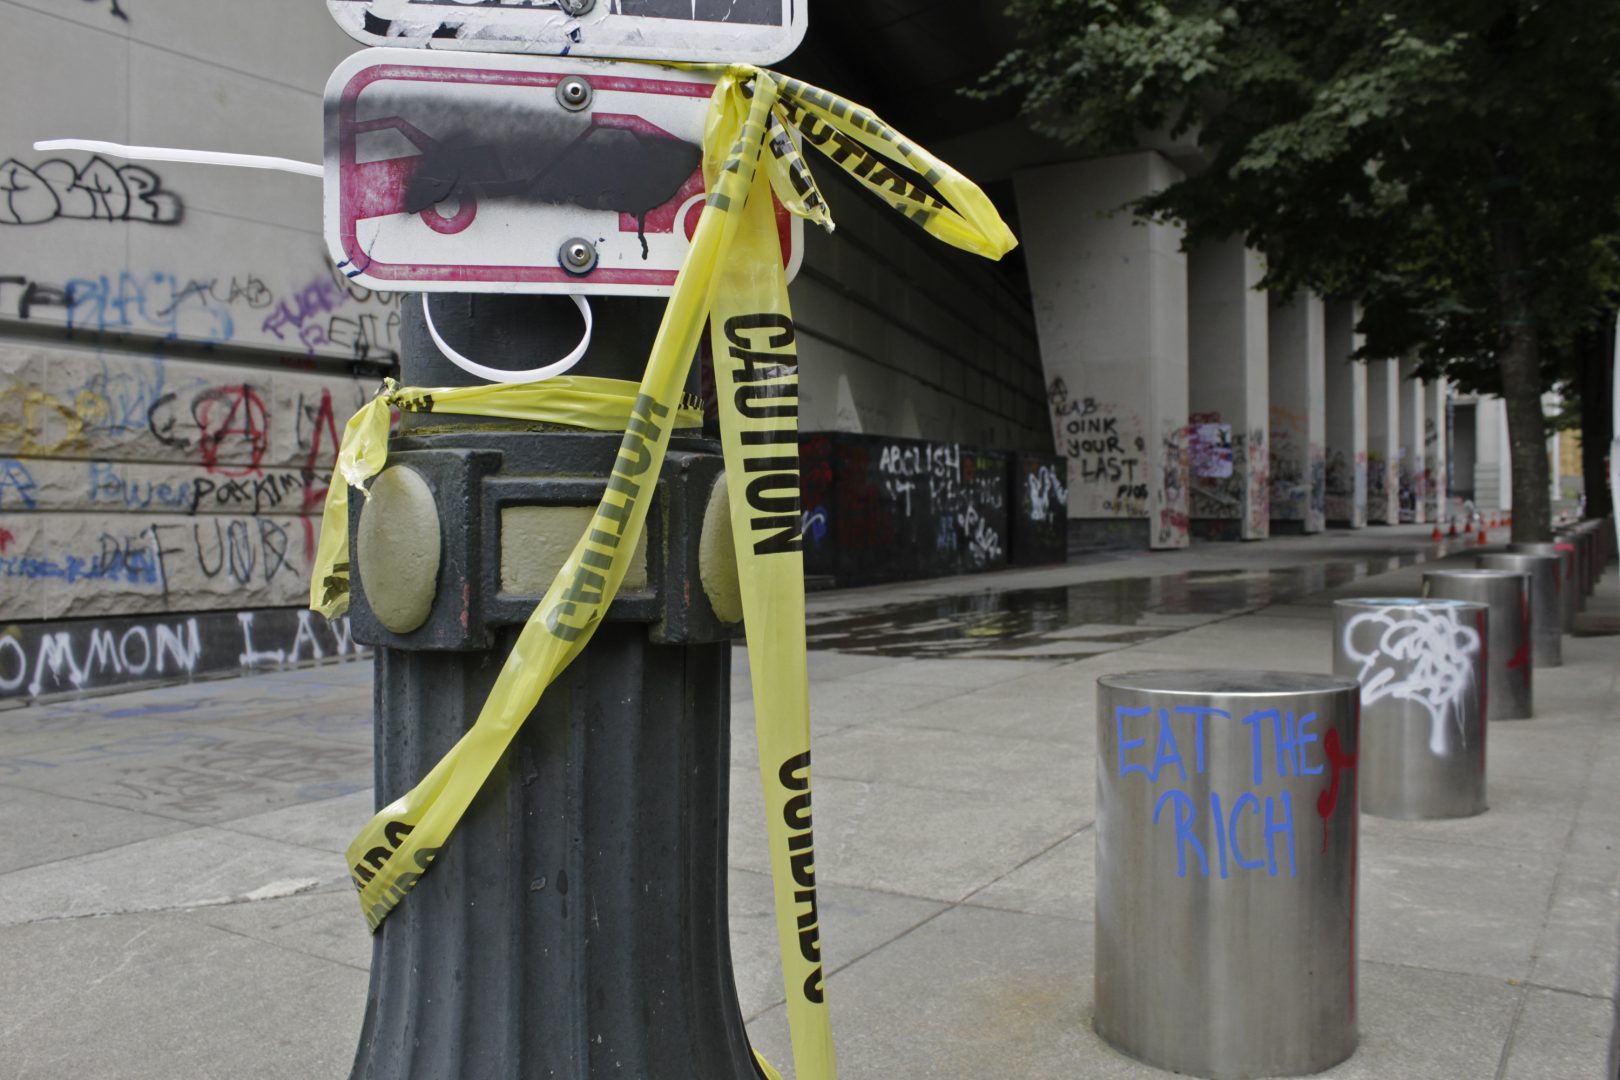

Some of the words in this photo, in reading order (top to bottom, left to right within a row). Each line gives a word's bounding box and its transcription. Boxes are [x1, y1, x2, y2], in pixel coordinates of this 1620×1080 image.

[1066, 417, 1118, 435] OINK
[1066, 436, 1125, 458] YOUR
[1081, 457, 1139, 483] LAST
[1115, 704, 1232, 783] EAT
[1241, 708, 1325, 785] THE
[1152, 788, 1297, 880] RICH
